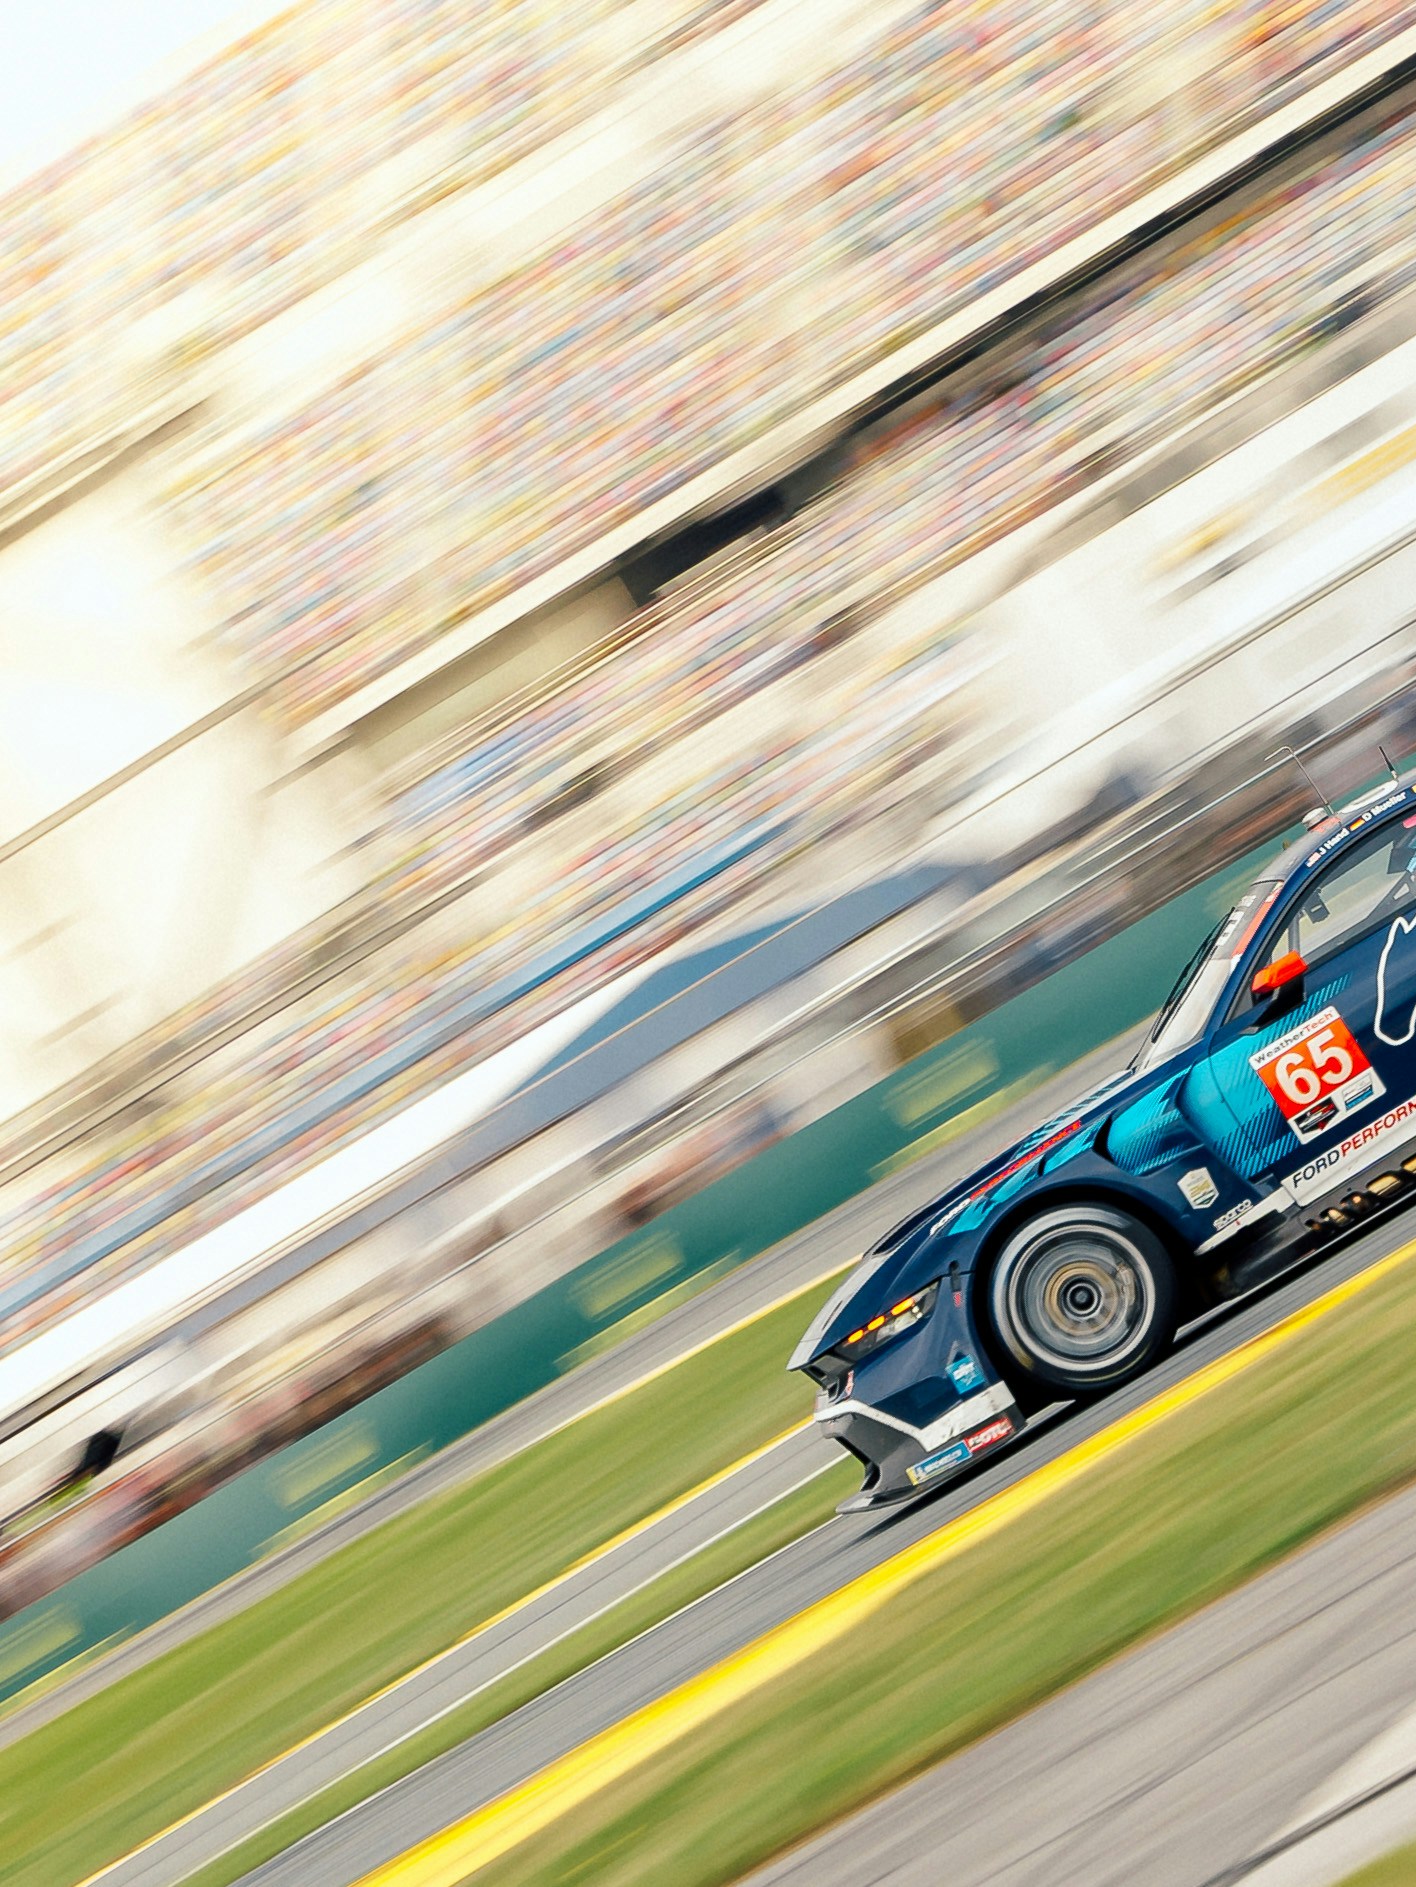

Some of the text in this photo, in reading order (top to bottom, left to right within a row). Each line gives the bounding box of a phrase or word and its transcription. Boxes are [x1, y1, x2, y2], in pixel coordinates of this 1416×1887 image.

[1361, 791, 1407, 822] D Mueller
[1254, 1011, 1333, 1064] WeatherTech
[1275, 1028, 1354, 1105] 65
